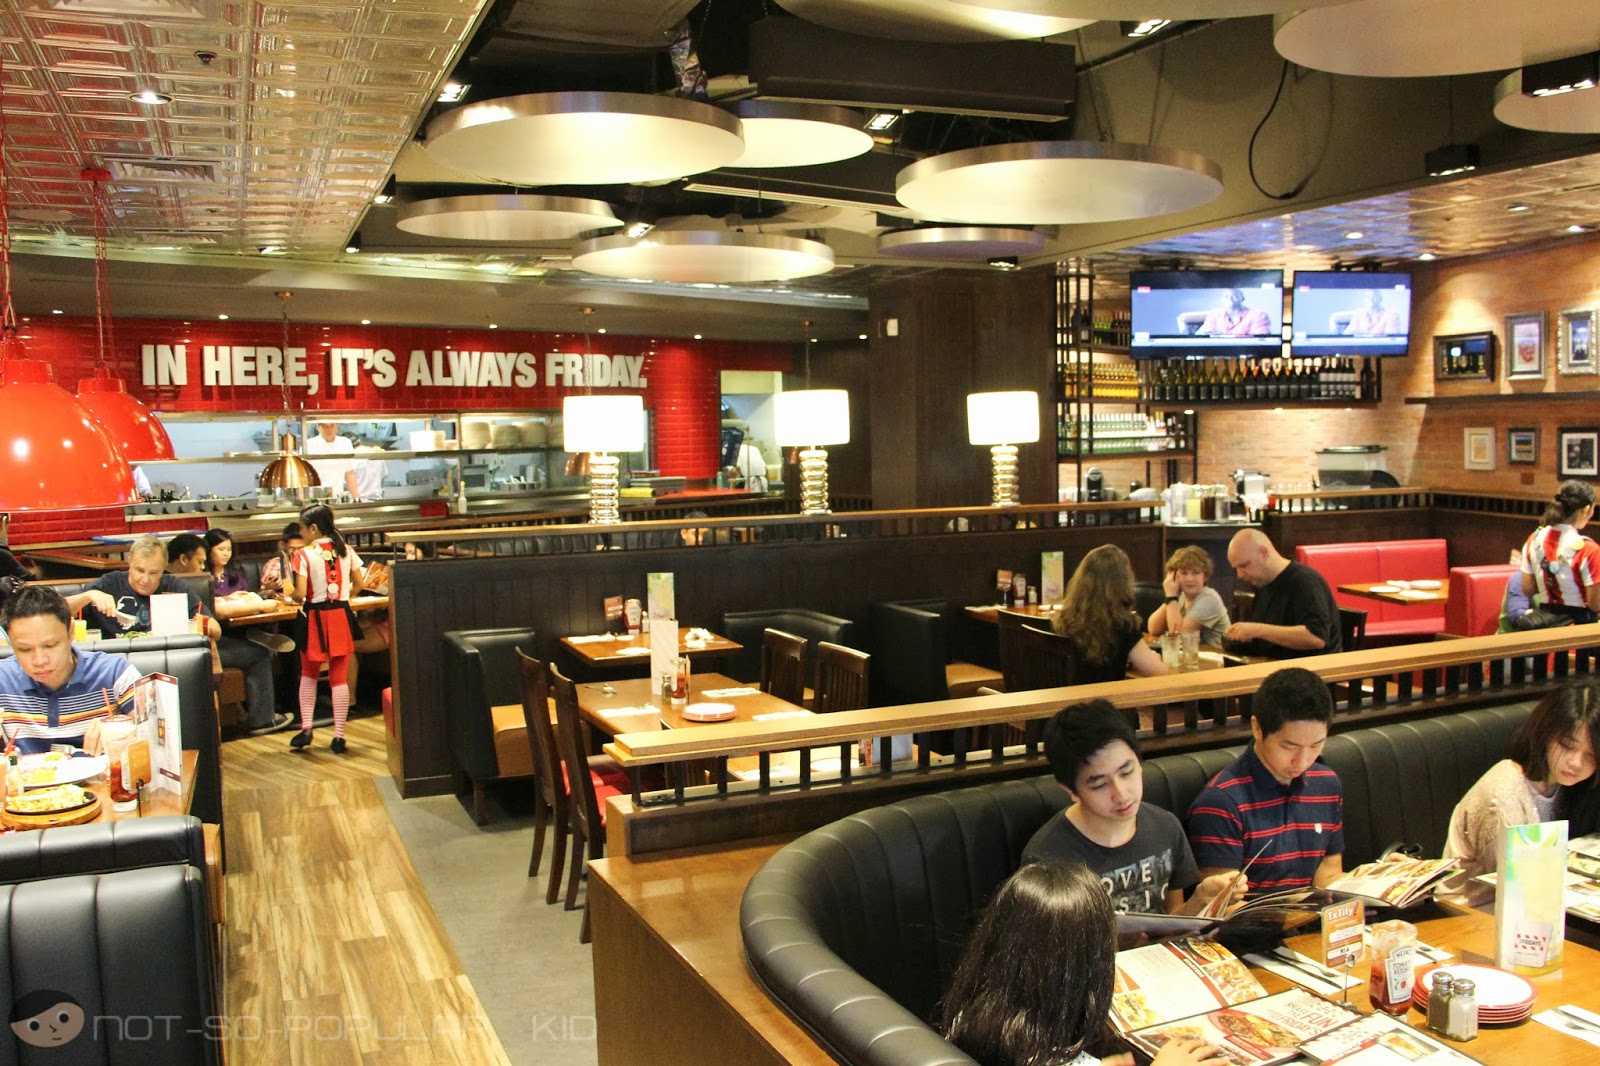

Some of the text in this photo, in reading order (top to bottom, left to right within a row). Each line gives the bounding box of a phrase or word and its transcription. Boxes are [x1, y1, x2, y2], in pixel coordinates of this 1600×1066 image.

[142, 344, 647, 395] IN HERE, IT'S ALWAYS FRIDAY.
[1300, 1012, 1339, 1028] FUN
